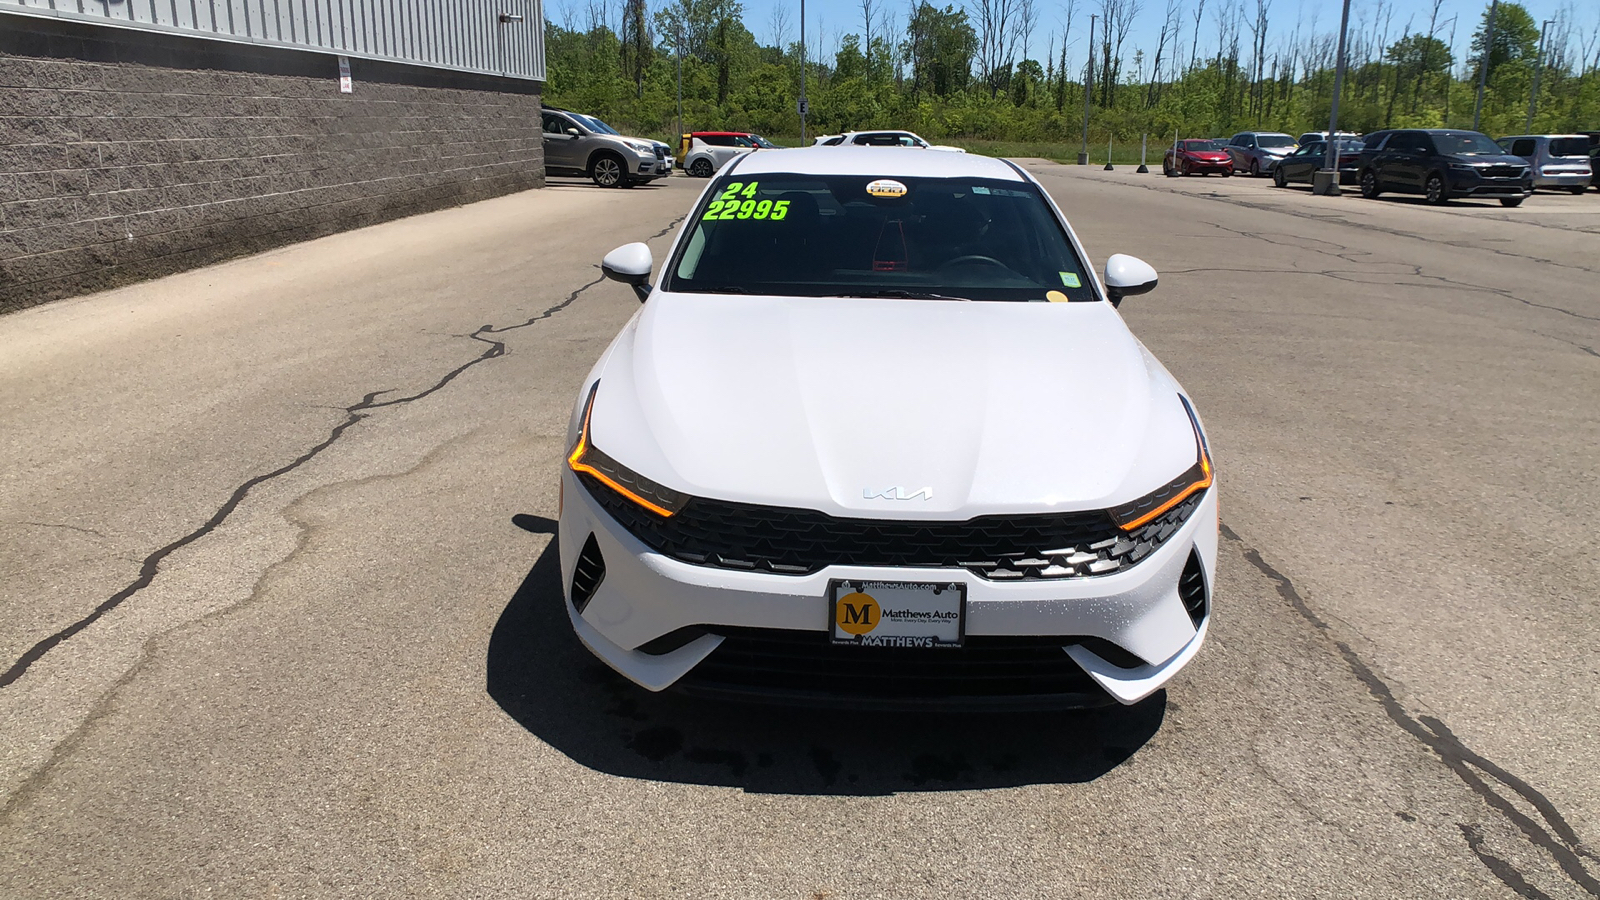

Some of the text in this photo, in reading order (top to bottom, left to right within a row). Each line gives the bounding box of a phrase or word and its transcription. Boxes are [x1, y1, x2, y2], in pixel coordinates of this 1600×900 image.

[800, 102, 805, 113] E
[720, 181, 759, 200] 24
[702, 199, 791, 221] 22995
[861, 581, 937, 591] MatthewsAuto.com
[841, 603, 873, 625] M
[882, 609, 958, 619] Matthews Auto
[861, 635, 933, 648] MATTHEWS
